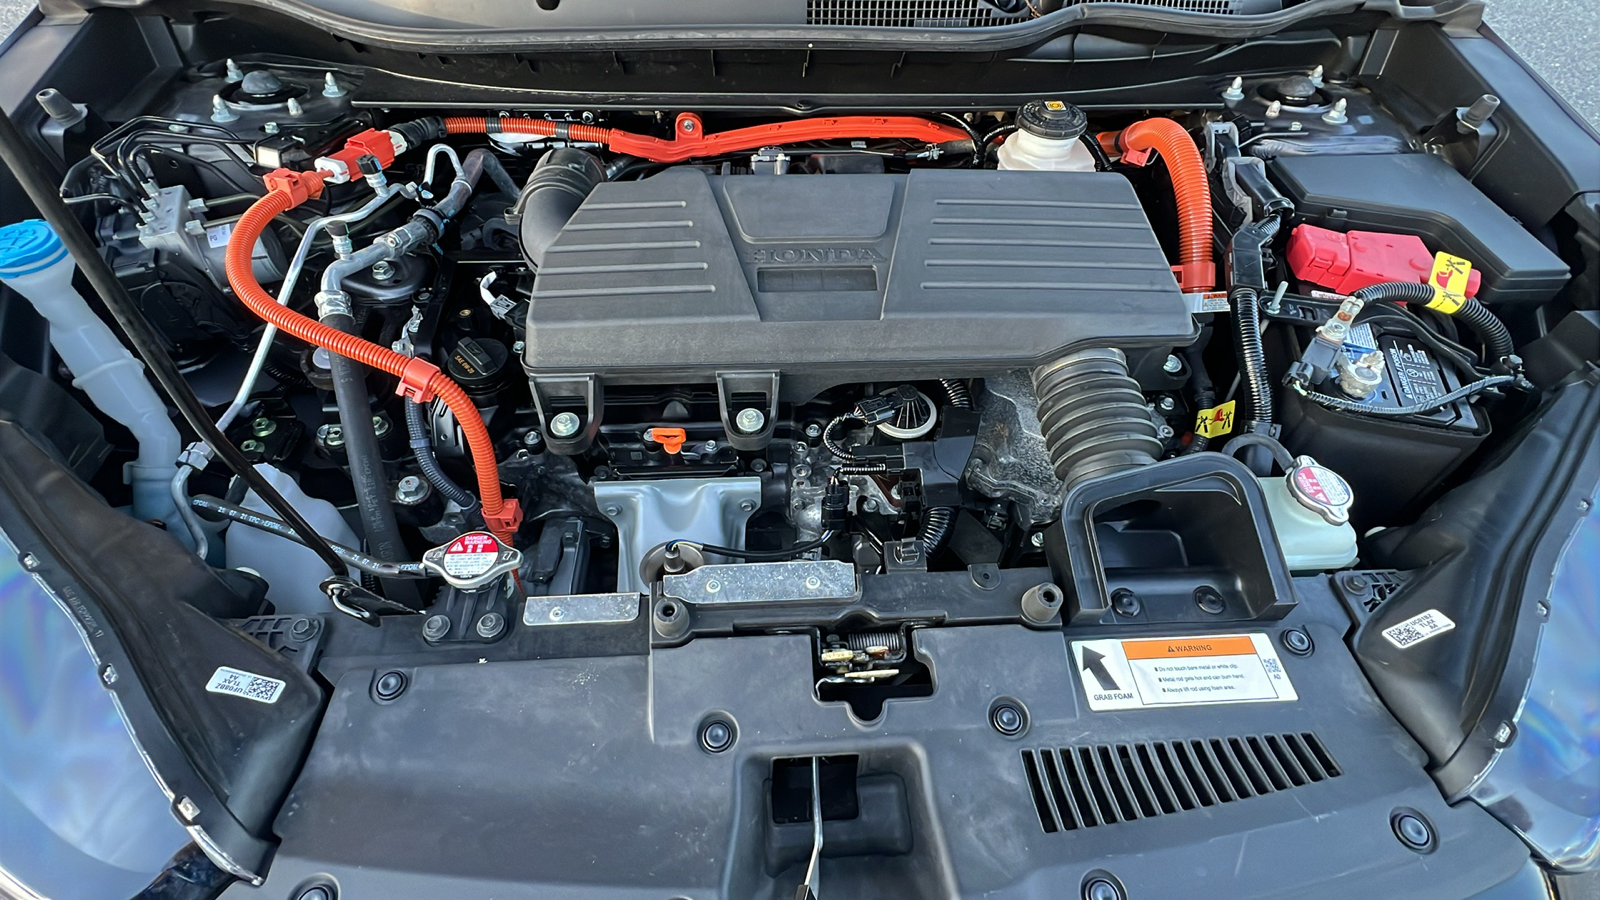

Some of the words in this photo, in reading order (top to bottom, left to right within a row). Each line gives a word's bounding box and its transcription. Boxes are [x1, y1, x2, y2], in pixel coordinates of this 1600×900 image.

[745, 248, 887, 264] HONDA
[1390, 348, 1402, 367] POISON
[1398, 372, 1411, 394] DANGER
[1175, 644, 1213, 652] WARNING
[222, 678, 240, 686] TLAX
[1093, 693, 1113, 701] GRAB
[1113, 692, 1134, 700] FOAM
